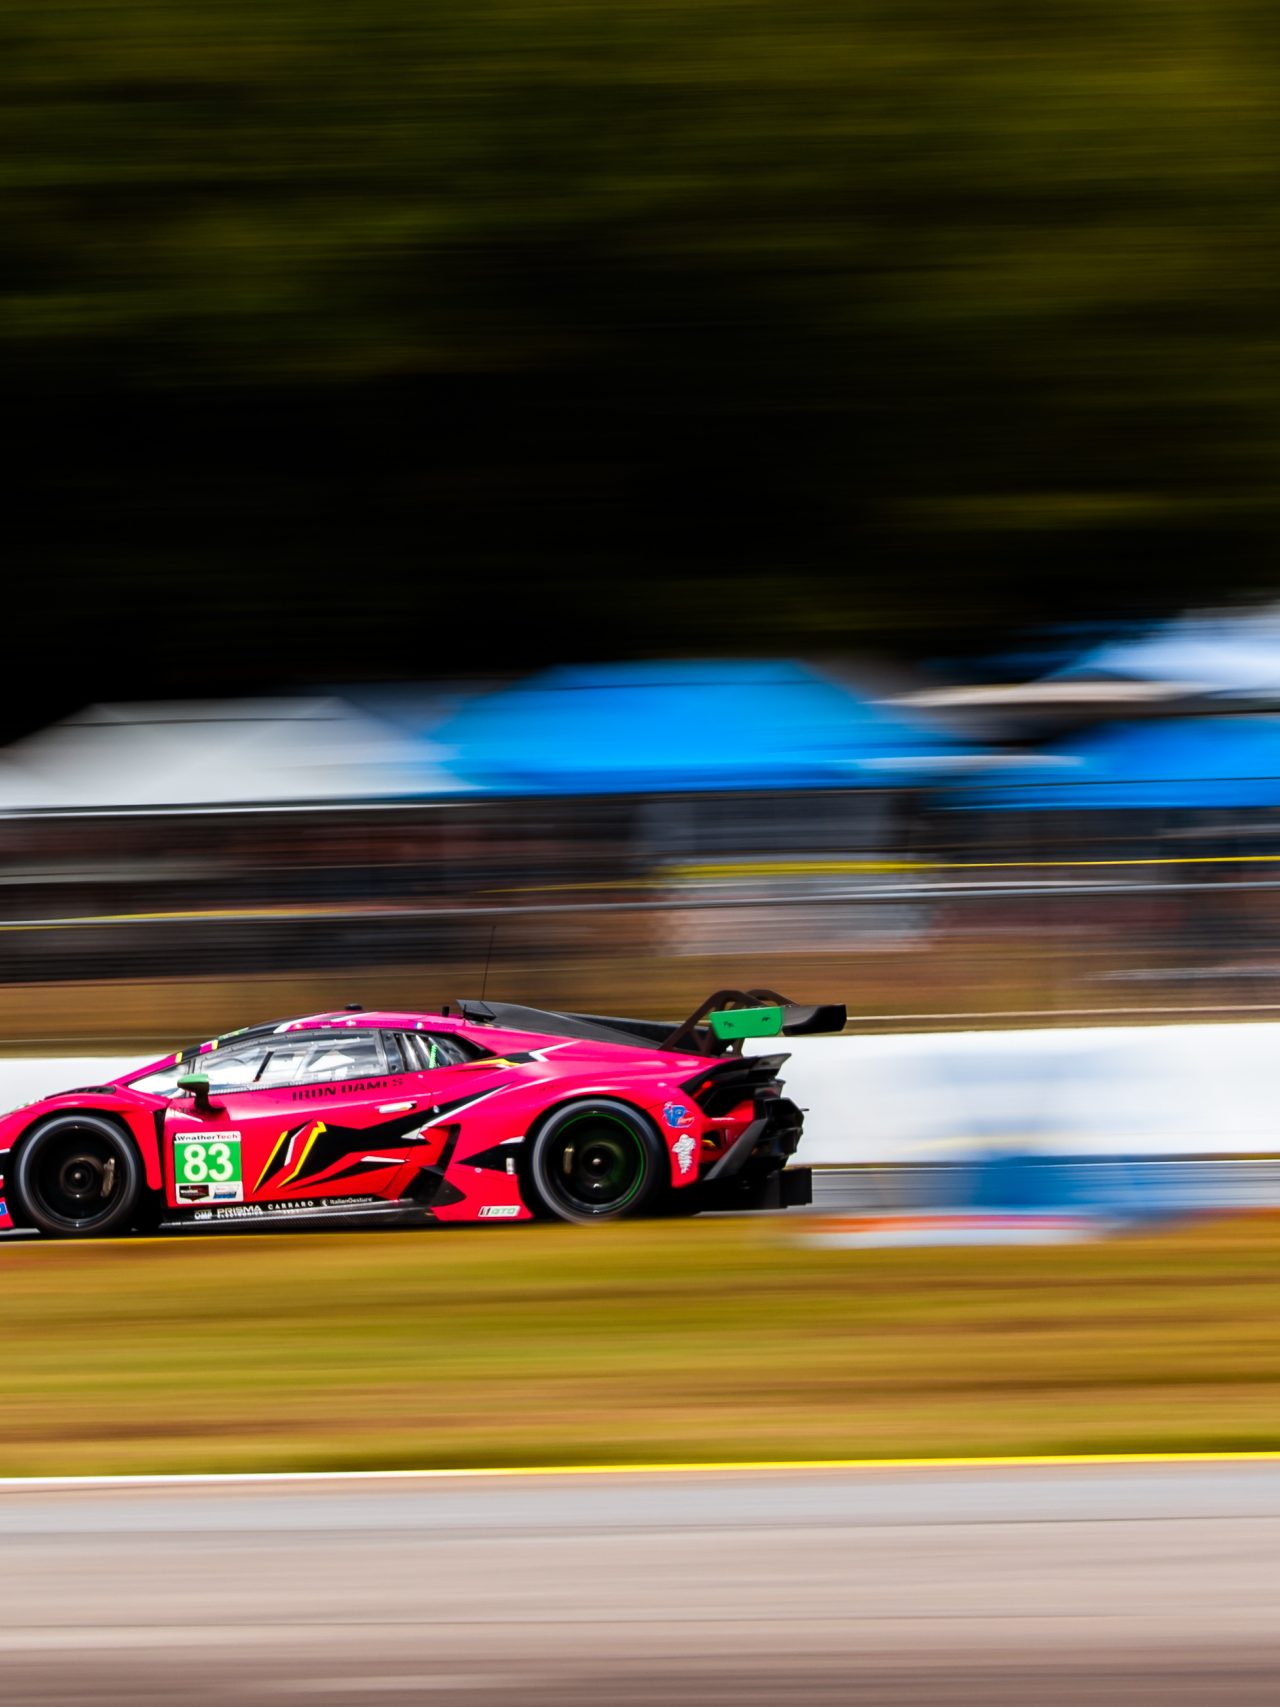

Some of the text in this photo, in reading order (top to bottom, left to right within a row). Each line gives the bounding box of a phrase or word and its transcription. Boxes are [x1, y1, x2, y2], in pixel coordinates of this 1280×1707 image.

[292, 1087, 336, 1101] IRON
[177, 1133, 238, 1141] WeatherTech
[183, 1142, 234, 1182] 83
[216, 1205, 263, 1216] PRISMA
[267, 1200, 314, 1210] CARRARO
